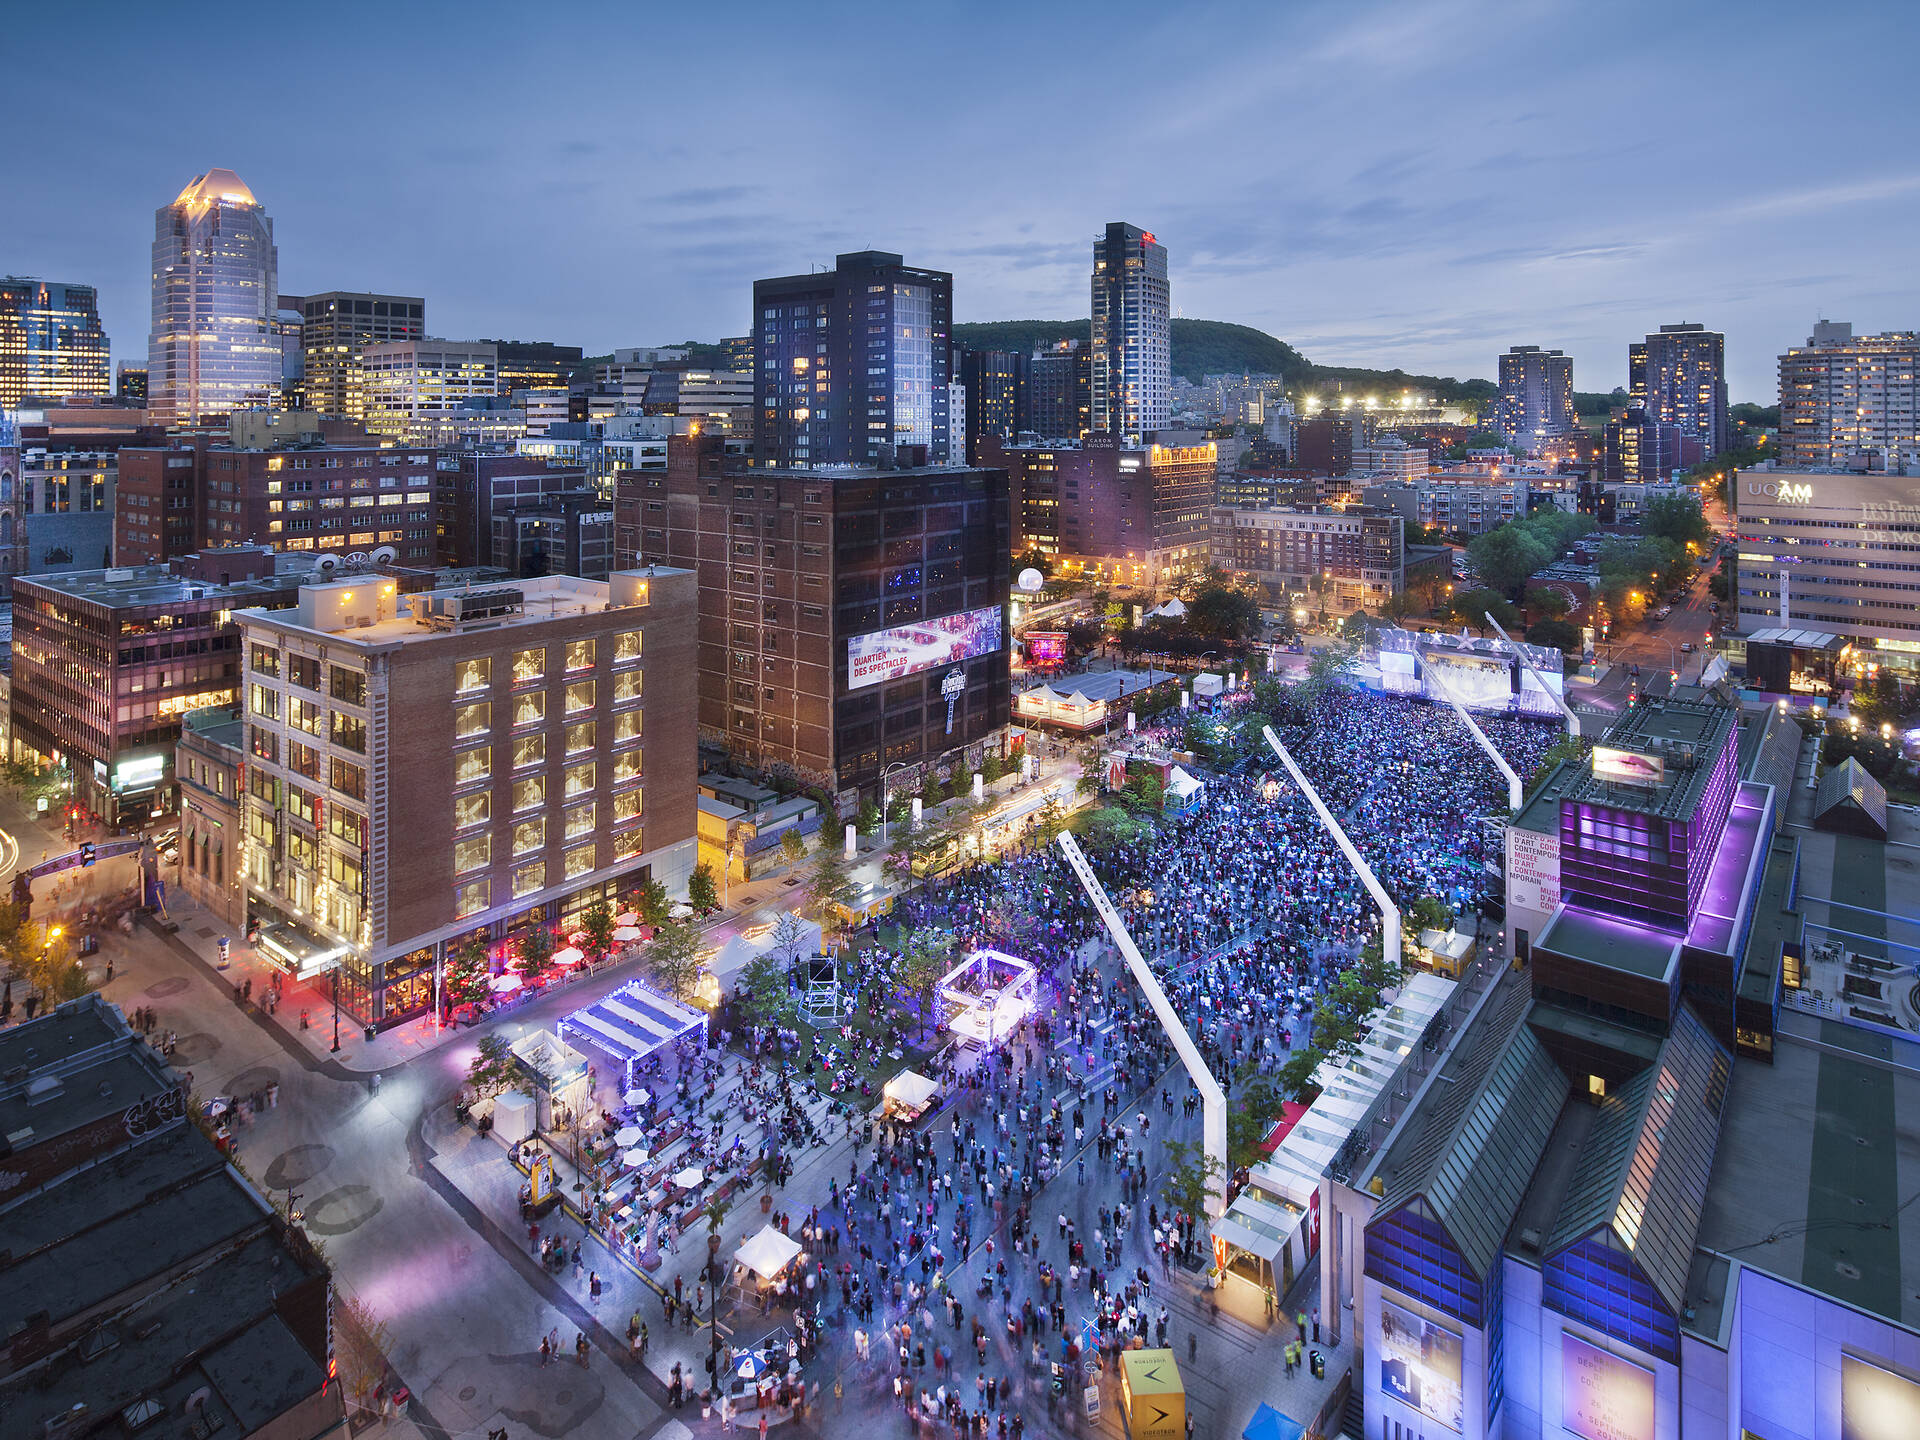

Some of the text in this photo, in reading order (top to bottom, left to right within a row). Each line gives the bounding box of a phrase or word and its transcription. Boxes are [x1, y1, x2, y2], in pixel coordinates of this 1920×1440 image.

[854, 651, 887, 666] QUARTIER
[854, 656, 908, 678] DES SPECTACLES
[1514, 837, 1535, 846] D'ART
[1514, 859, 1535, 868] D'ART
